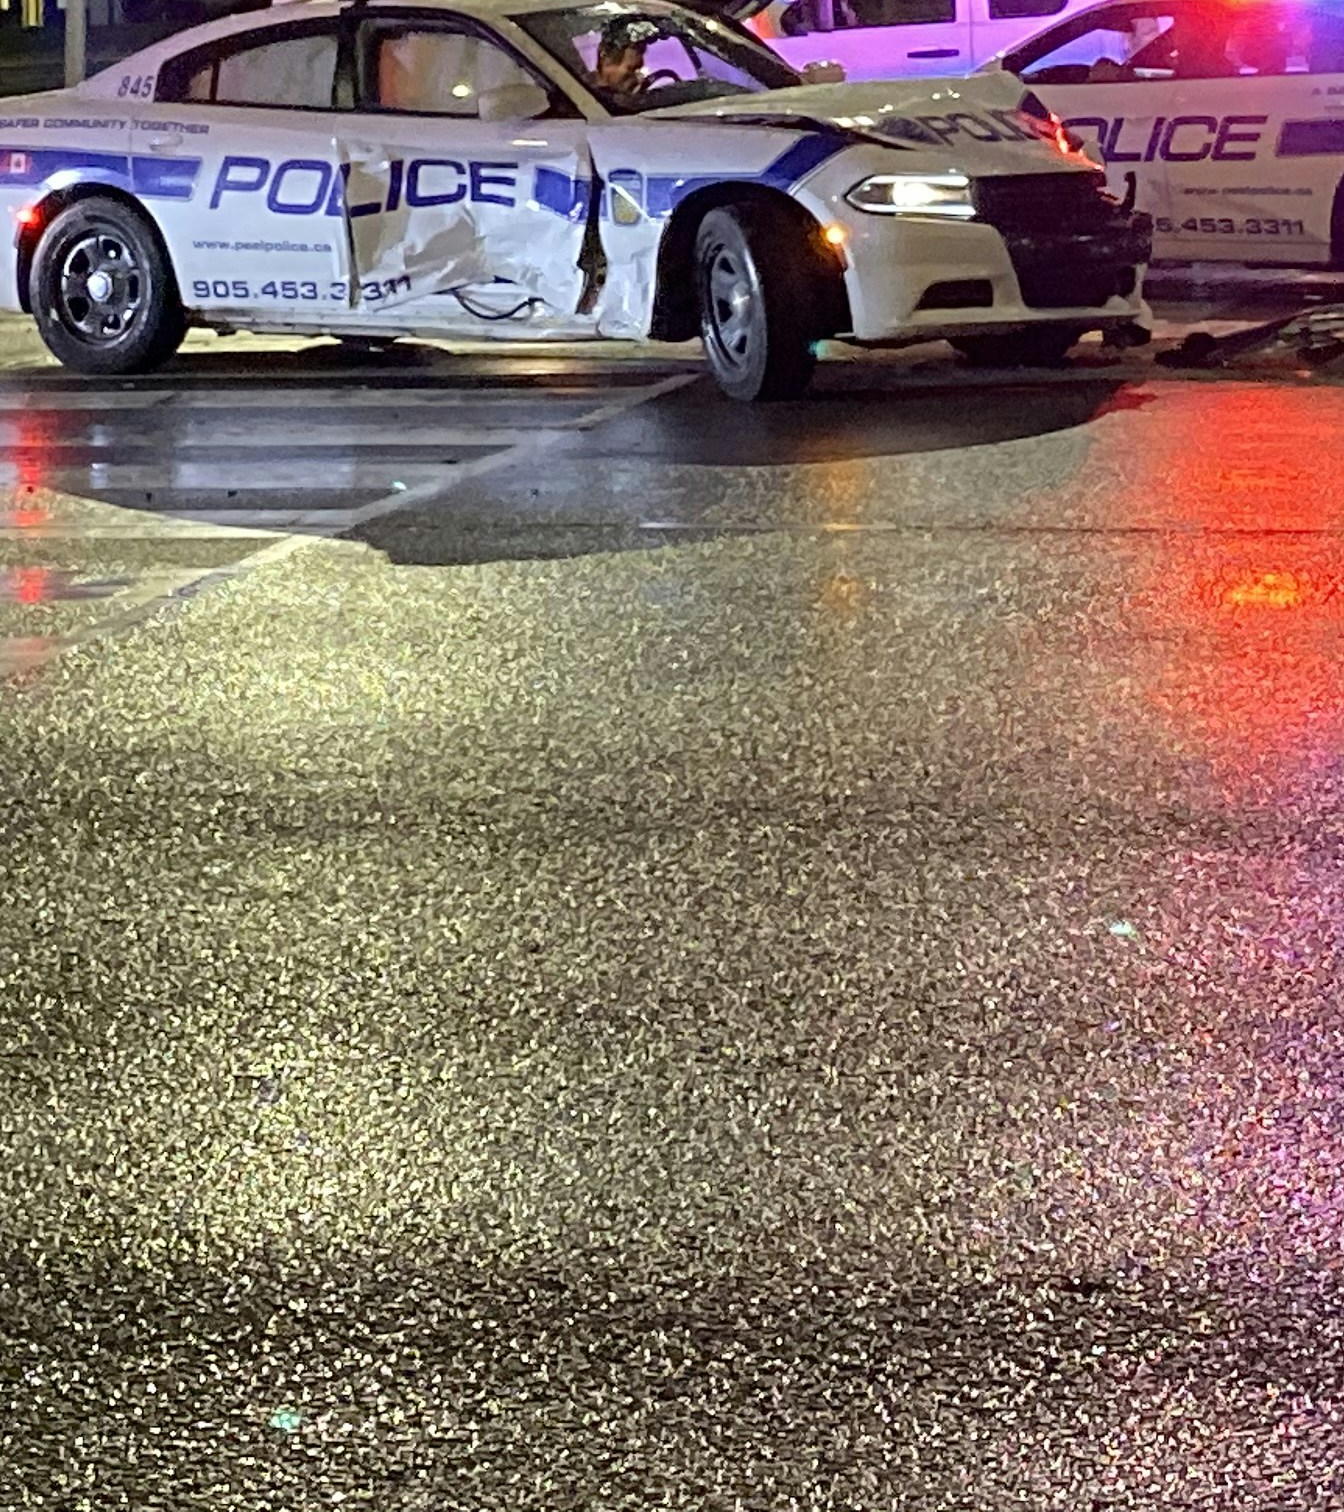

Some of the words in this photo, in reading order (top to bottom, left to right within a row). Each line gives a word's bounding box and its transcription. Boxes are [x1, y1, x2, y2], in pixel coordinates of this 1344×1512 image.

[117, 75, 154, 98] 845
[43, 118, 127, 130] COMMUNITY
[131, 119, 210, 134] TOGETHER
[1061, 115, 1269, 162] OLICE
[209, 155, 519, 218] POLICE
[1155, 217, 1305, 235] 5.453.3311
[192, 240, 332, 253] www.peelpolice.ca
